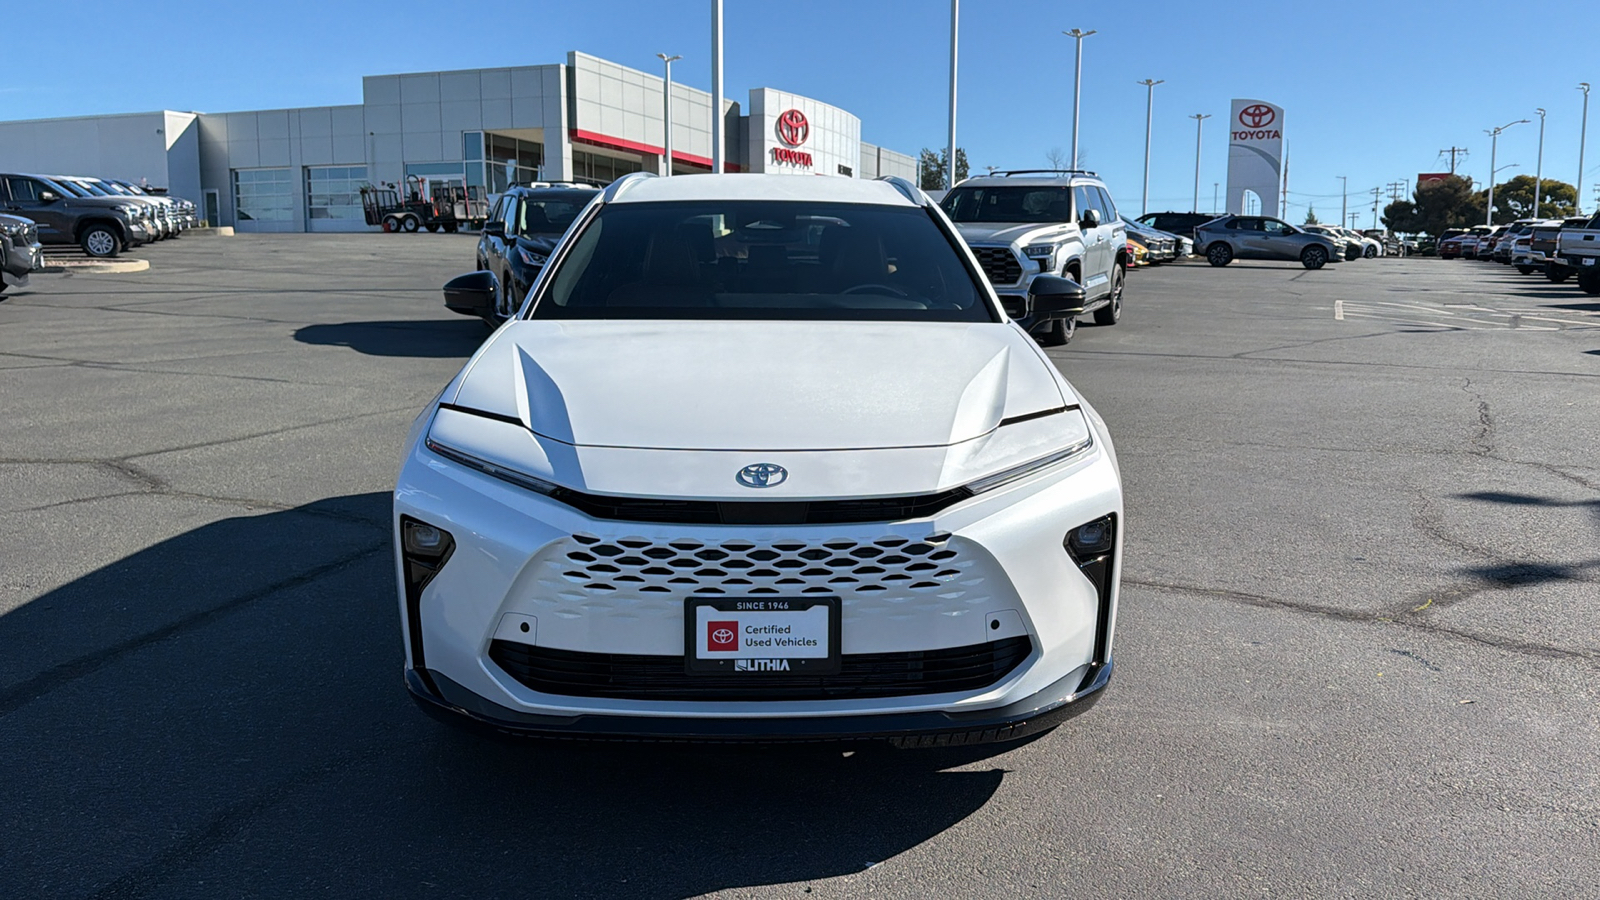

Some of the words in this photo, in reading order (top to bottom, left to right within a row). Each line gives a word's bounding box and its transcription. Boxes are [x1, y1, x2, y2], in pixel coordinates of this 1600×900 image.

[1231, 129, 1281, 140] TOYOTA
[773, 147, 813, 166] TOYOTA
[736, 602, 765, 610] SINCE
[768, 602, 789, 610] 1946
[745, 625, 791, 634] Certified
[745, 638, 772, 647] Used
[774, 637, 817, 647] Vehicles
[747, 659, 790, 671] LITHIA
